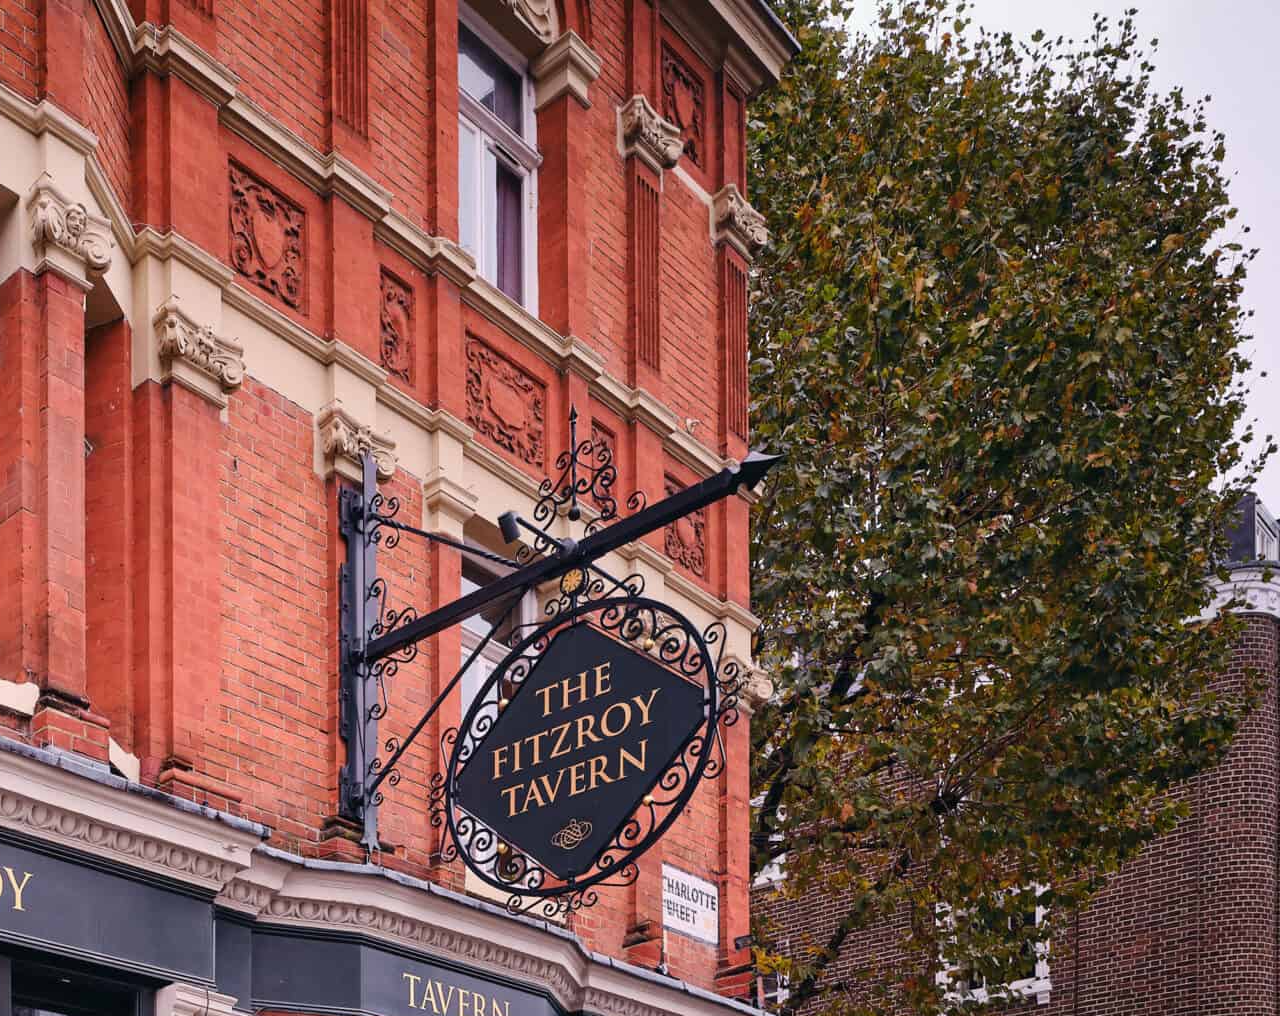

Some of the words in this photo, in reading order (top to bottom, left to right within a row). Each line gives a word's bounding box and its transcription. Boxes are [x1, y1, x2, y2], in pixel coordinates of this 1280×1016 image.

[535, 661, 612, 718] THE
[491, 687, 662, 781] FITZROY
[500, 738, 649, 818] TAVERN
[662, 876, 717, 912] HARLOTTE
